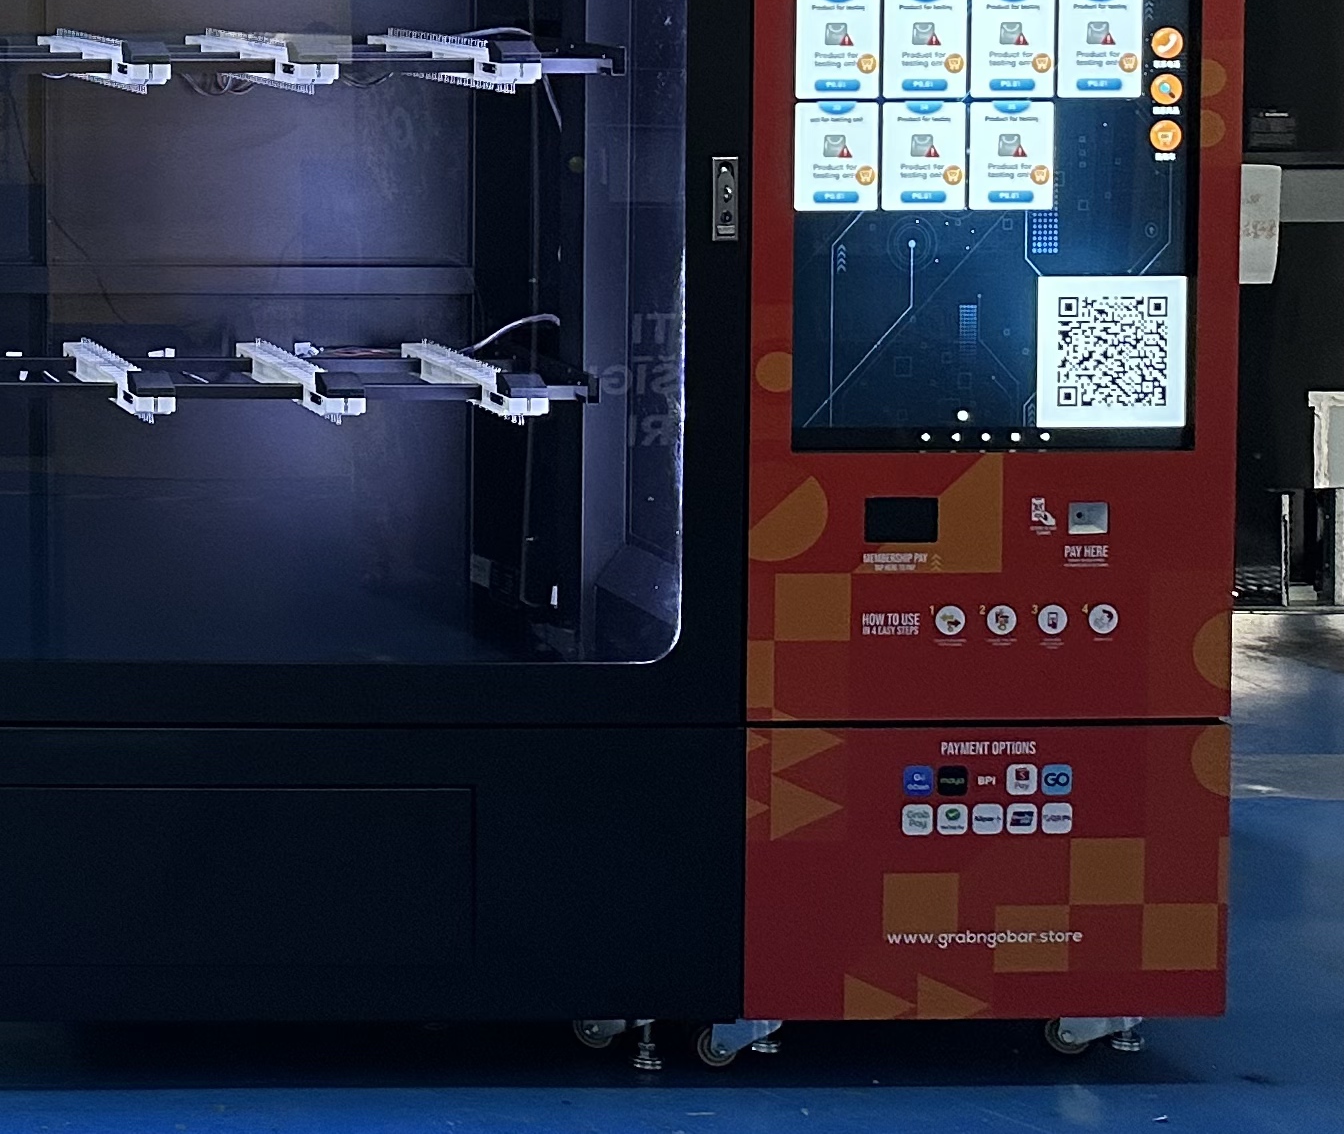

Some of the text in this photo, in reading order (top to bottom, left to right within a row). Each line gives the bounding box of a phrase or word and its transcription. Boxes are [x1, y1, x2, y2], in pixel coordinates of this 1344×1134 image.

[814, 51, 860, 59] Product for
[901, 51, 947, 59] Product for
[989, 51, 1034, 59] Product for
[1076, 51, 1121, 59] Product for
[813, 163, 858, 171] Product for
[900, 163, 946, 171] Product for
[988, 163, 1033, 171] Product for
[1064, 546, 1108, 558] PAY HERE
[862, 553, 928, 563] MEMBERSHIP PAY
[930, 605, 934, 615] 1
[979, 605, 986, 614] 2
[1032, 604, 1038, 614] 3
[1082, 604, 1088, 614] 4
[862, 613, 920, 625] HOW TO USE
[872, 626, 876, 634] 4
[878, 626, 895, 635] EASY
[896, 626, 918, 635] STEPS
[941, 742, 1036, 754] PAYMENT OPTIONS
[978, 776, 996, 785] BPI
[1044, 772, 1070, 786] GO
[1014, 782, 1030, 791] Pay
[907, 810, 930, 818] Grab
[909, 818, 927, 829] Pay
[887, 930, 1082, 948] www.grabngobar.store
